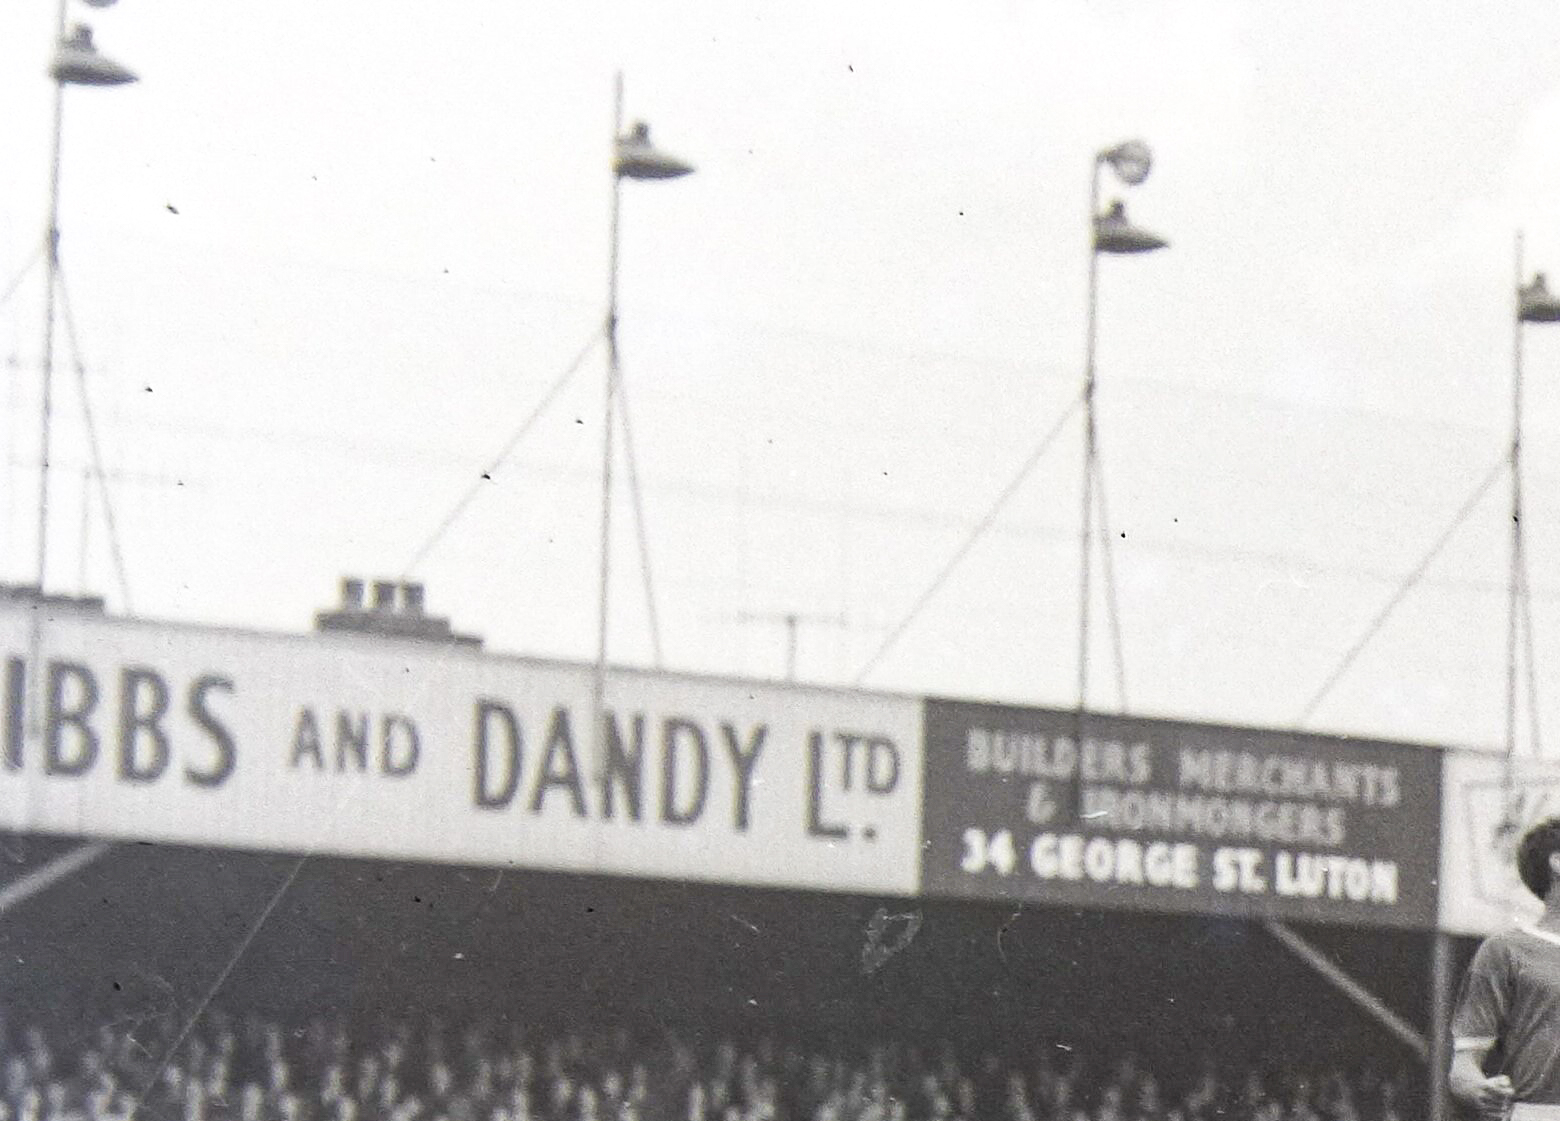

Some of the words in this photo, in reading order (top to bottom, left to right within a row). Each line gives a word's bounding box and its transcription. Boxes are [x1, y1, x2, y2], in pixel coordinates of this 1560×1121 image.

[4, 656, 237, 788] IBBS
[288, 705, 421, 778] AND
[471, 698, 768, 832] DANDY
[966, 728, 1151, 784] BUILDERS
[1179, 750, 1400, 808] MERCHANTS
[1080, 787, 1346, 847] IRONMONGERS
[960, 826, 1017, 879] 34
[1030, 832, 1200, 890] GEORGE
[1275, 850, 1398, 905] LUTON
